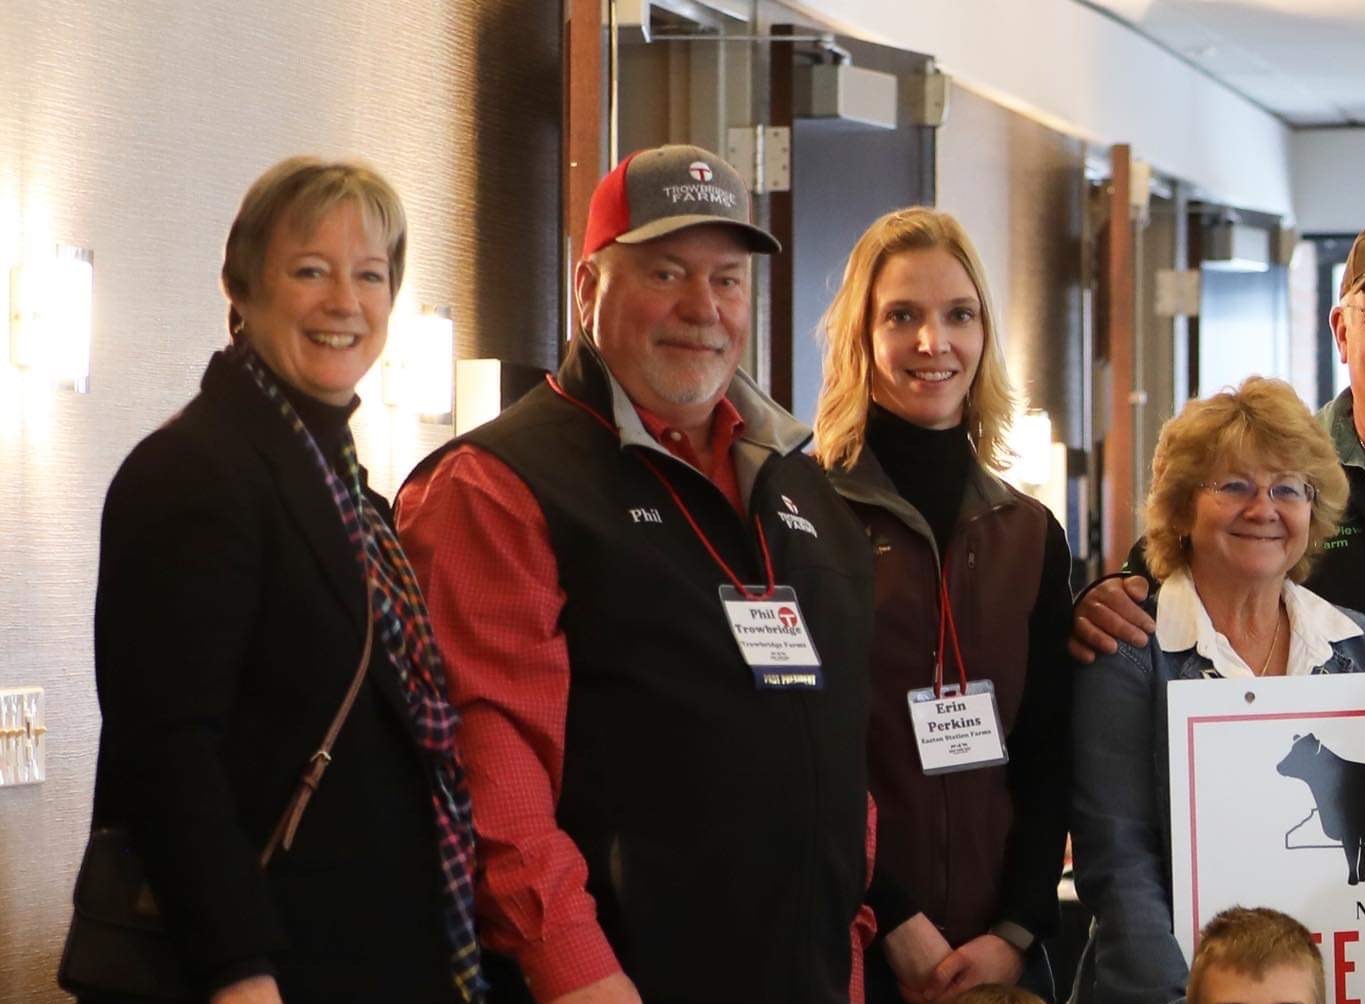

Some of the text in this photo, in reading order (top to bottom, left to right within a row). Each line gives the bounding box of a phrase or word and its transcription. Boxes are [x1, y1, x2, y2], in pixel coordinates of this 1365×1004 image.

[629, 507, 663, 524] Phil
[1322, 538, 1349, 550] arm
[749, 608, 776, 620] Phil
[734, 623, 803, 637] Trowbridge
[936, 701, 967, 715] Erin
[927, 717, 982, 733] Perkins
